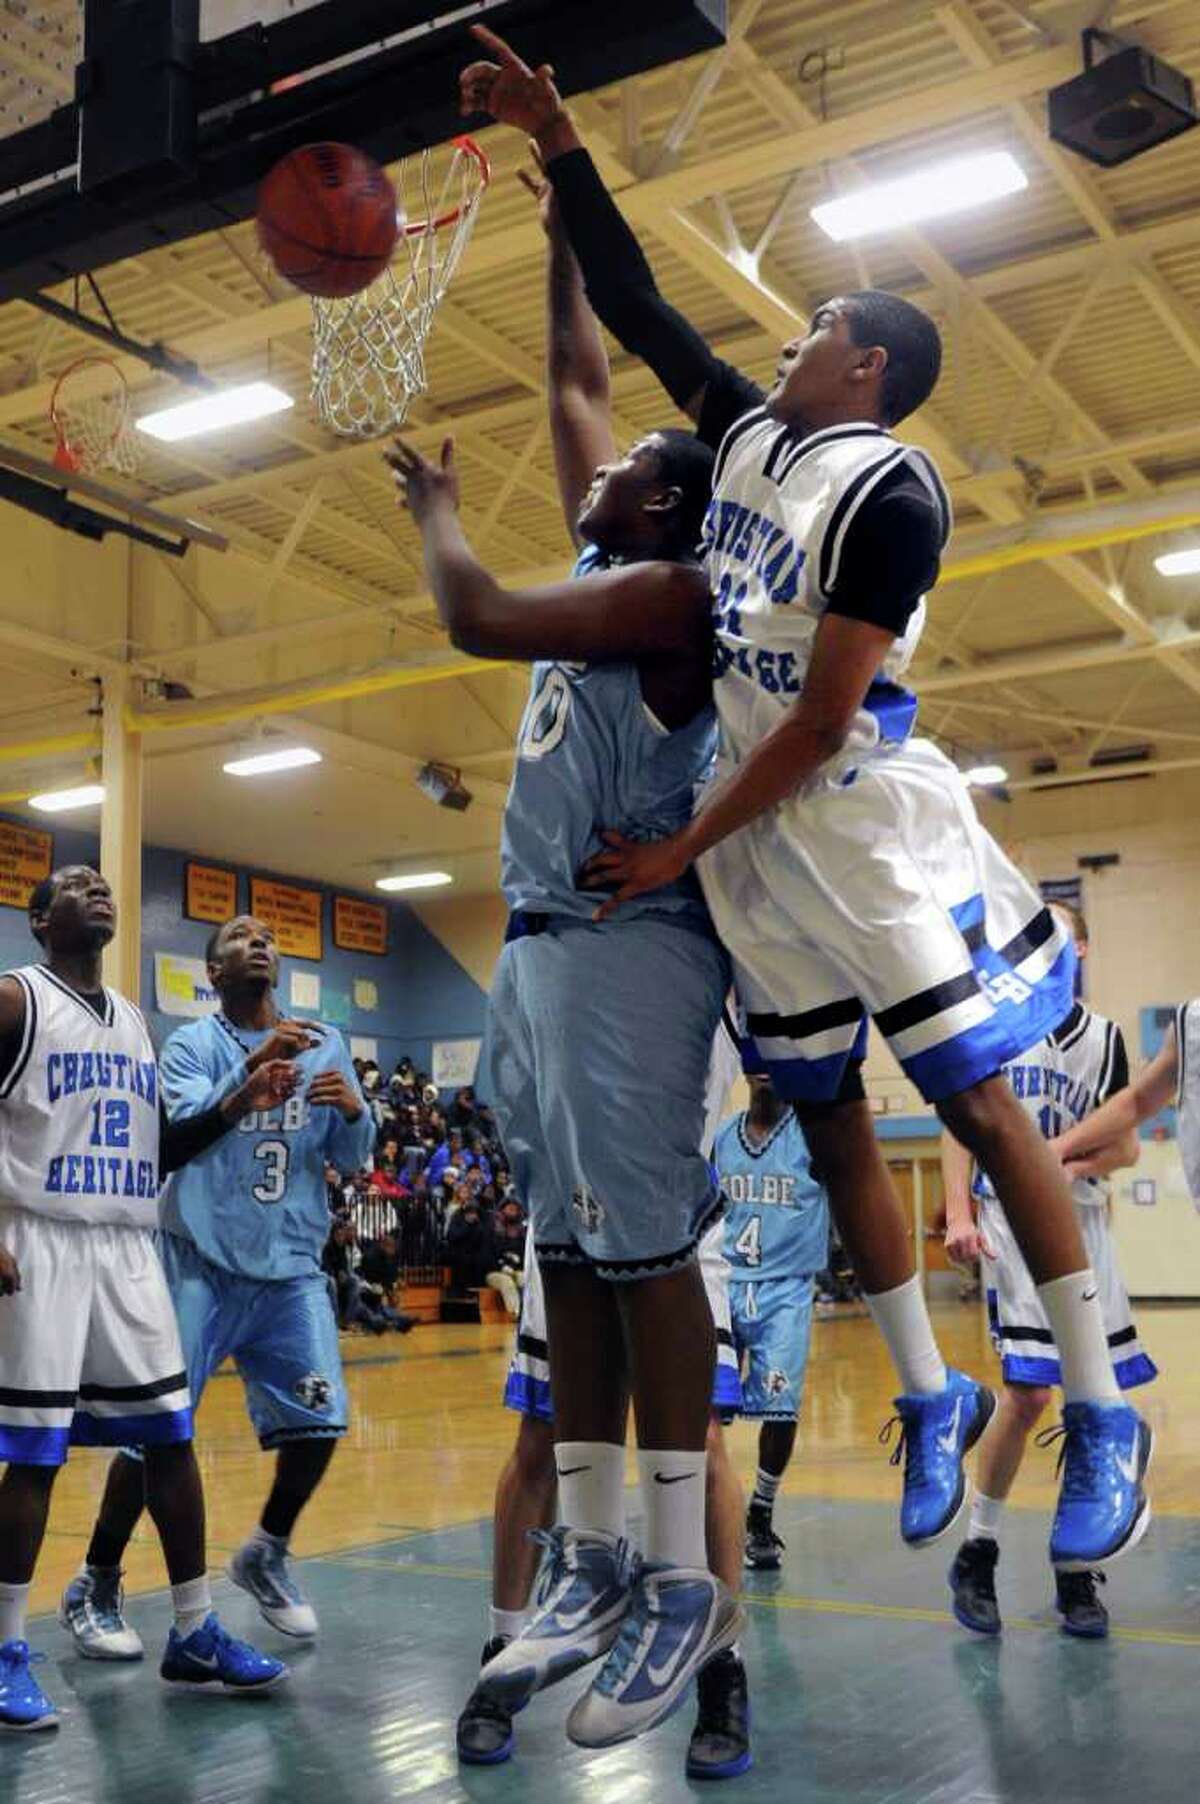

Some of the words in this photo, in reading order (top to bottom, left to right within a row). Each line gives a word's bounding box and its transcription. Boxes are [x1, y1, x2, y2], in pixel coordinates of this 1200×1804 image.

[90, 1099, 129, 1148] 12
[238, 1096, 311, 1133] OLB
[252, 1139, 290, 1204] 3
[734, 1214, 762, 1267] 4
